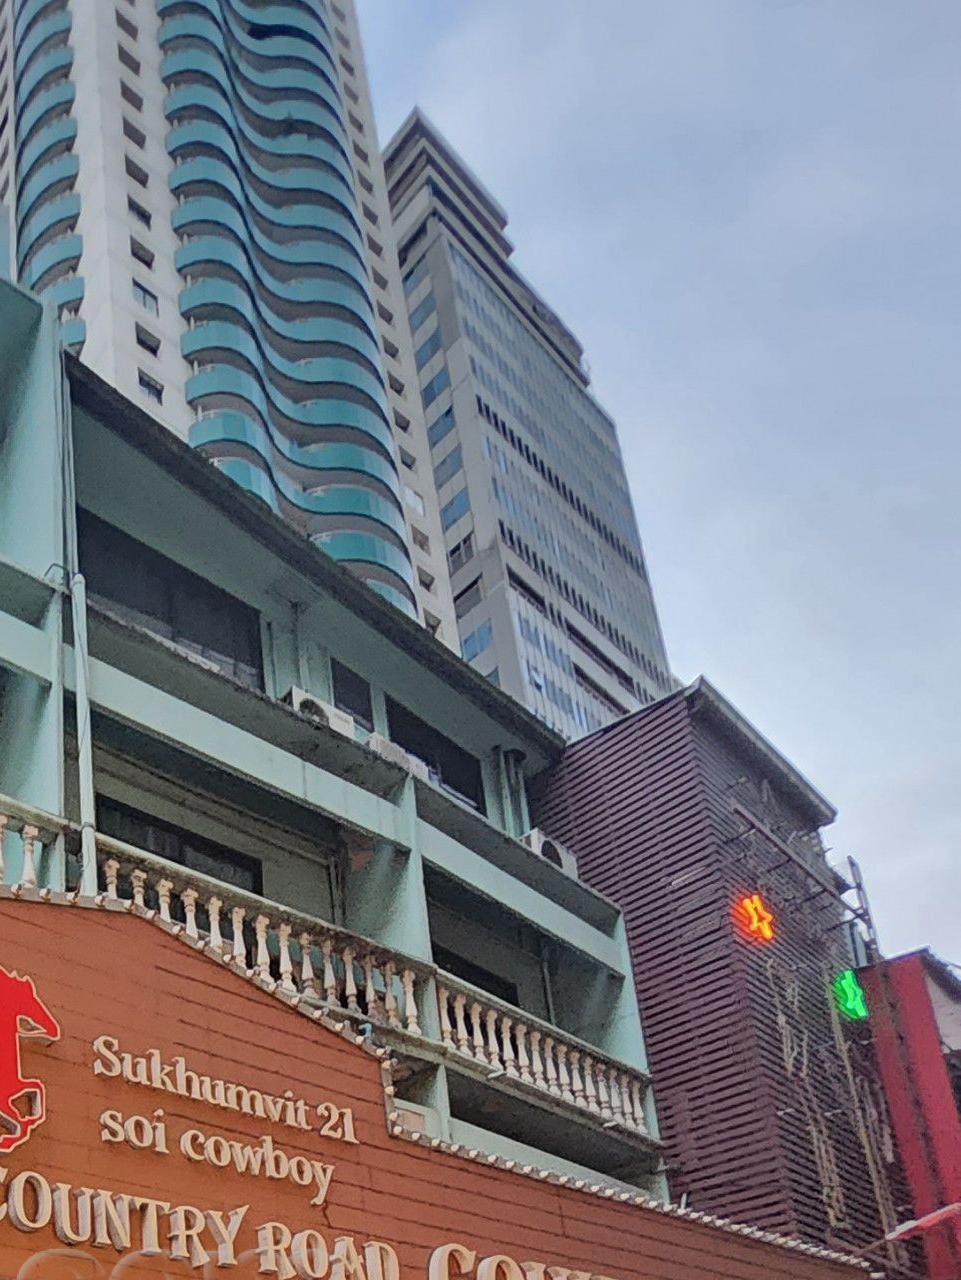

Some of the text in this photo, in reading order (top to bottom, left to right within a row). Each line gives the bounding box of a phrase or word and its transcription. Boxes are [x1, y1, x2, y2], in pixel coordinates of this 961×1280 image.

[92, 1035, 360, 1144] Sukhumvit 21
[99, 1108, 336, 1206] soi cowboy
